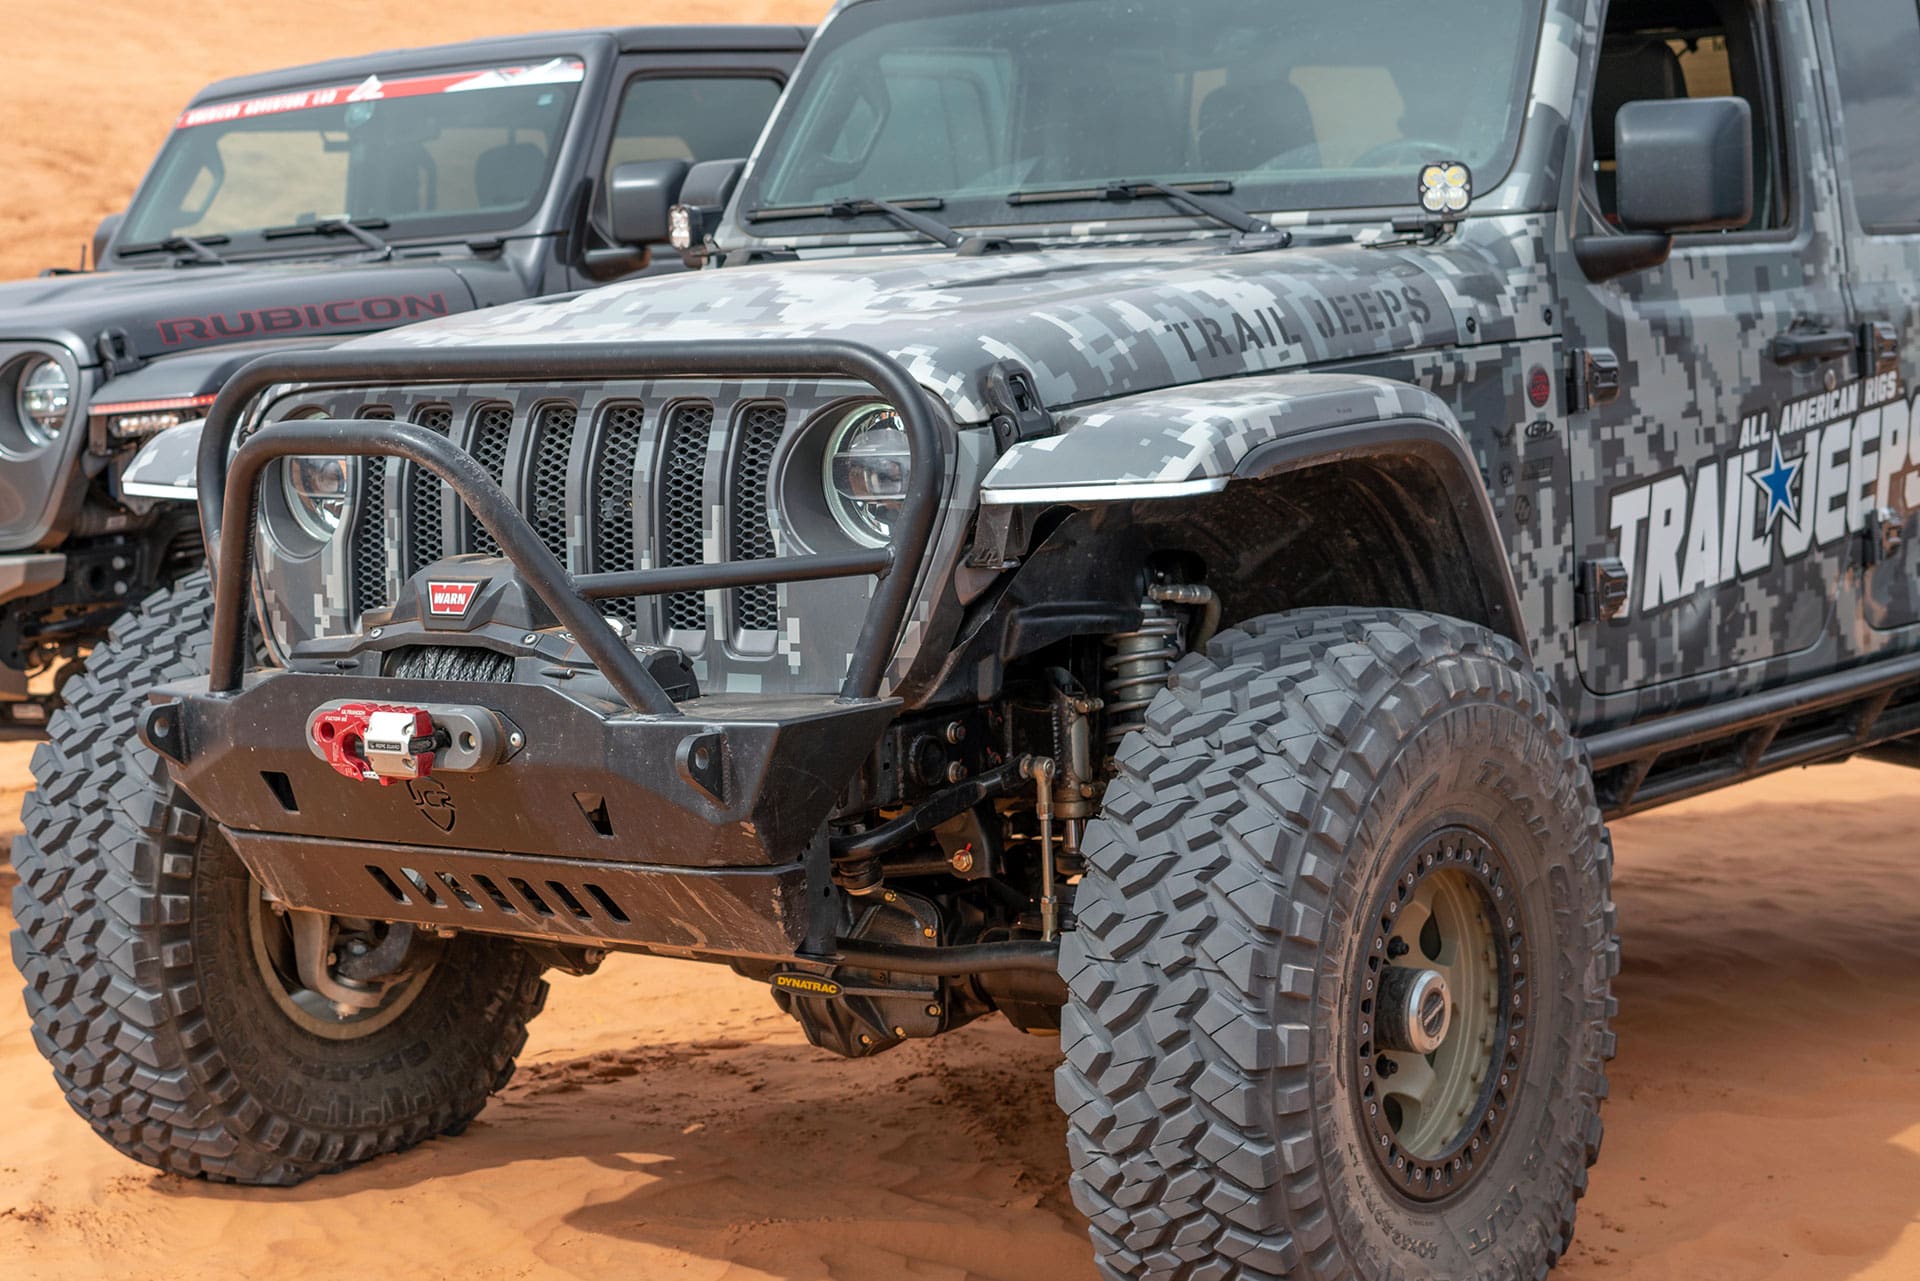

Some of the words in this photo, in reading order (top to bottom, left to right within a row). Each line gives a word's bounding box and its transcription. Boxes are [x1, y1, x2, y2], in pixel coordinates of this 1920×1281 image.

[157, 292, 448, 345] RUBICON
[1163, 306, 1302, 362] TRAIL
[1313, 286, 1431, 339] JEEPS
[1738, 412, 1771, 449] ALL
[1779, 382, 1859, 436] AMERICAN
[1864, 370, 1897, 407] RIGS
[1610, 449, 1773, 618] TRAIL
[434, 592, 466, 605] WARN
[778, 976, 837, 994] DYNATRAC
